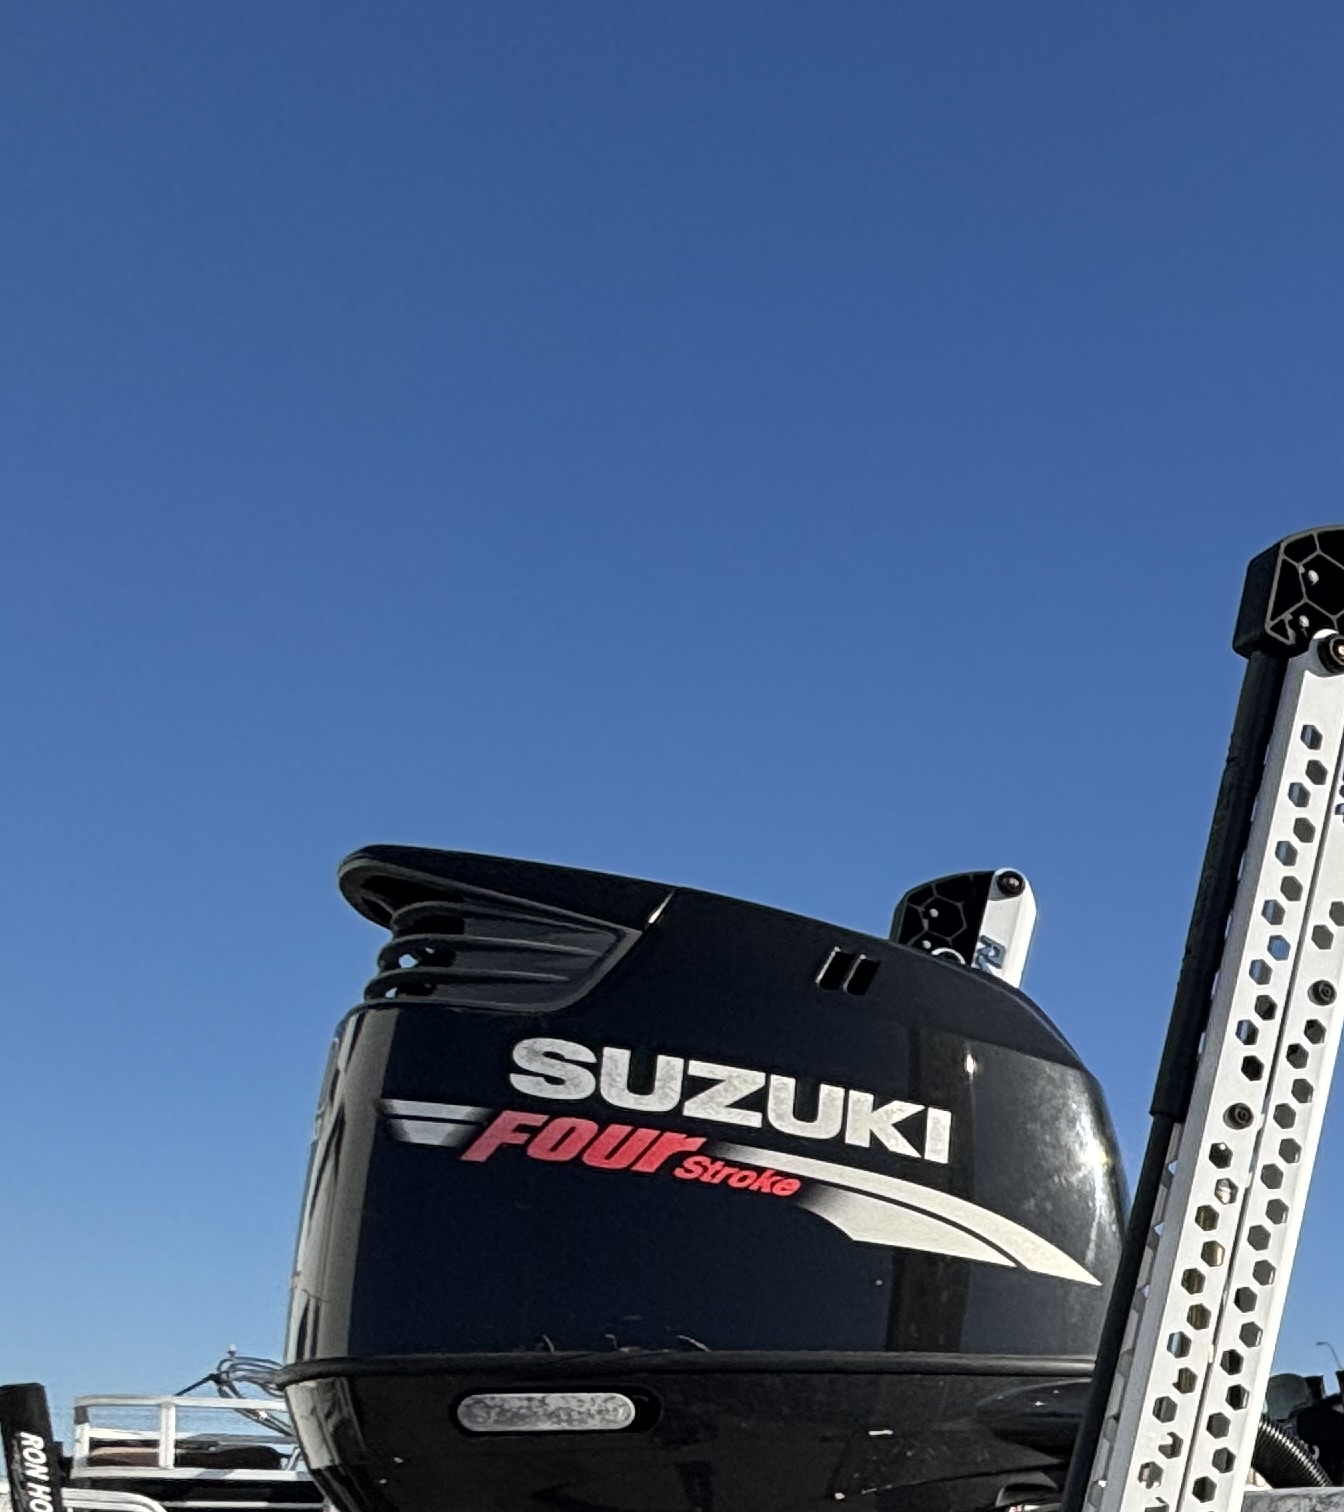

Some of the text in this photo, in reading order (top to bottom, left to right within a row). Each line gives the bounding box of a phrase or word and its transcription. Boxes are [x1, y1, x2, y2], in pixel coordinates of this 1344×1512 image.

[508, 1036, 952, 1165] SUZUKI
[674, 1155, 803, 1198] Stroke
[19, 1431, 50, 1482] RON
